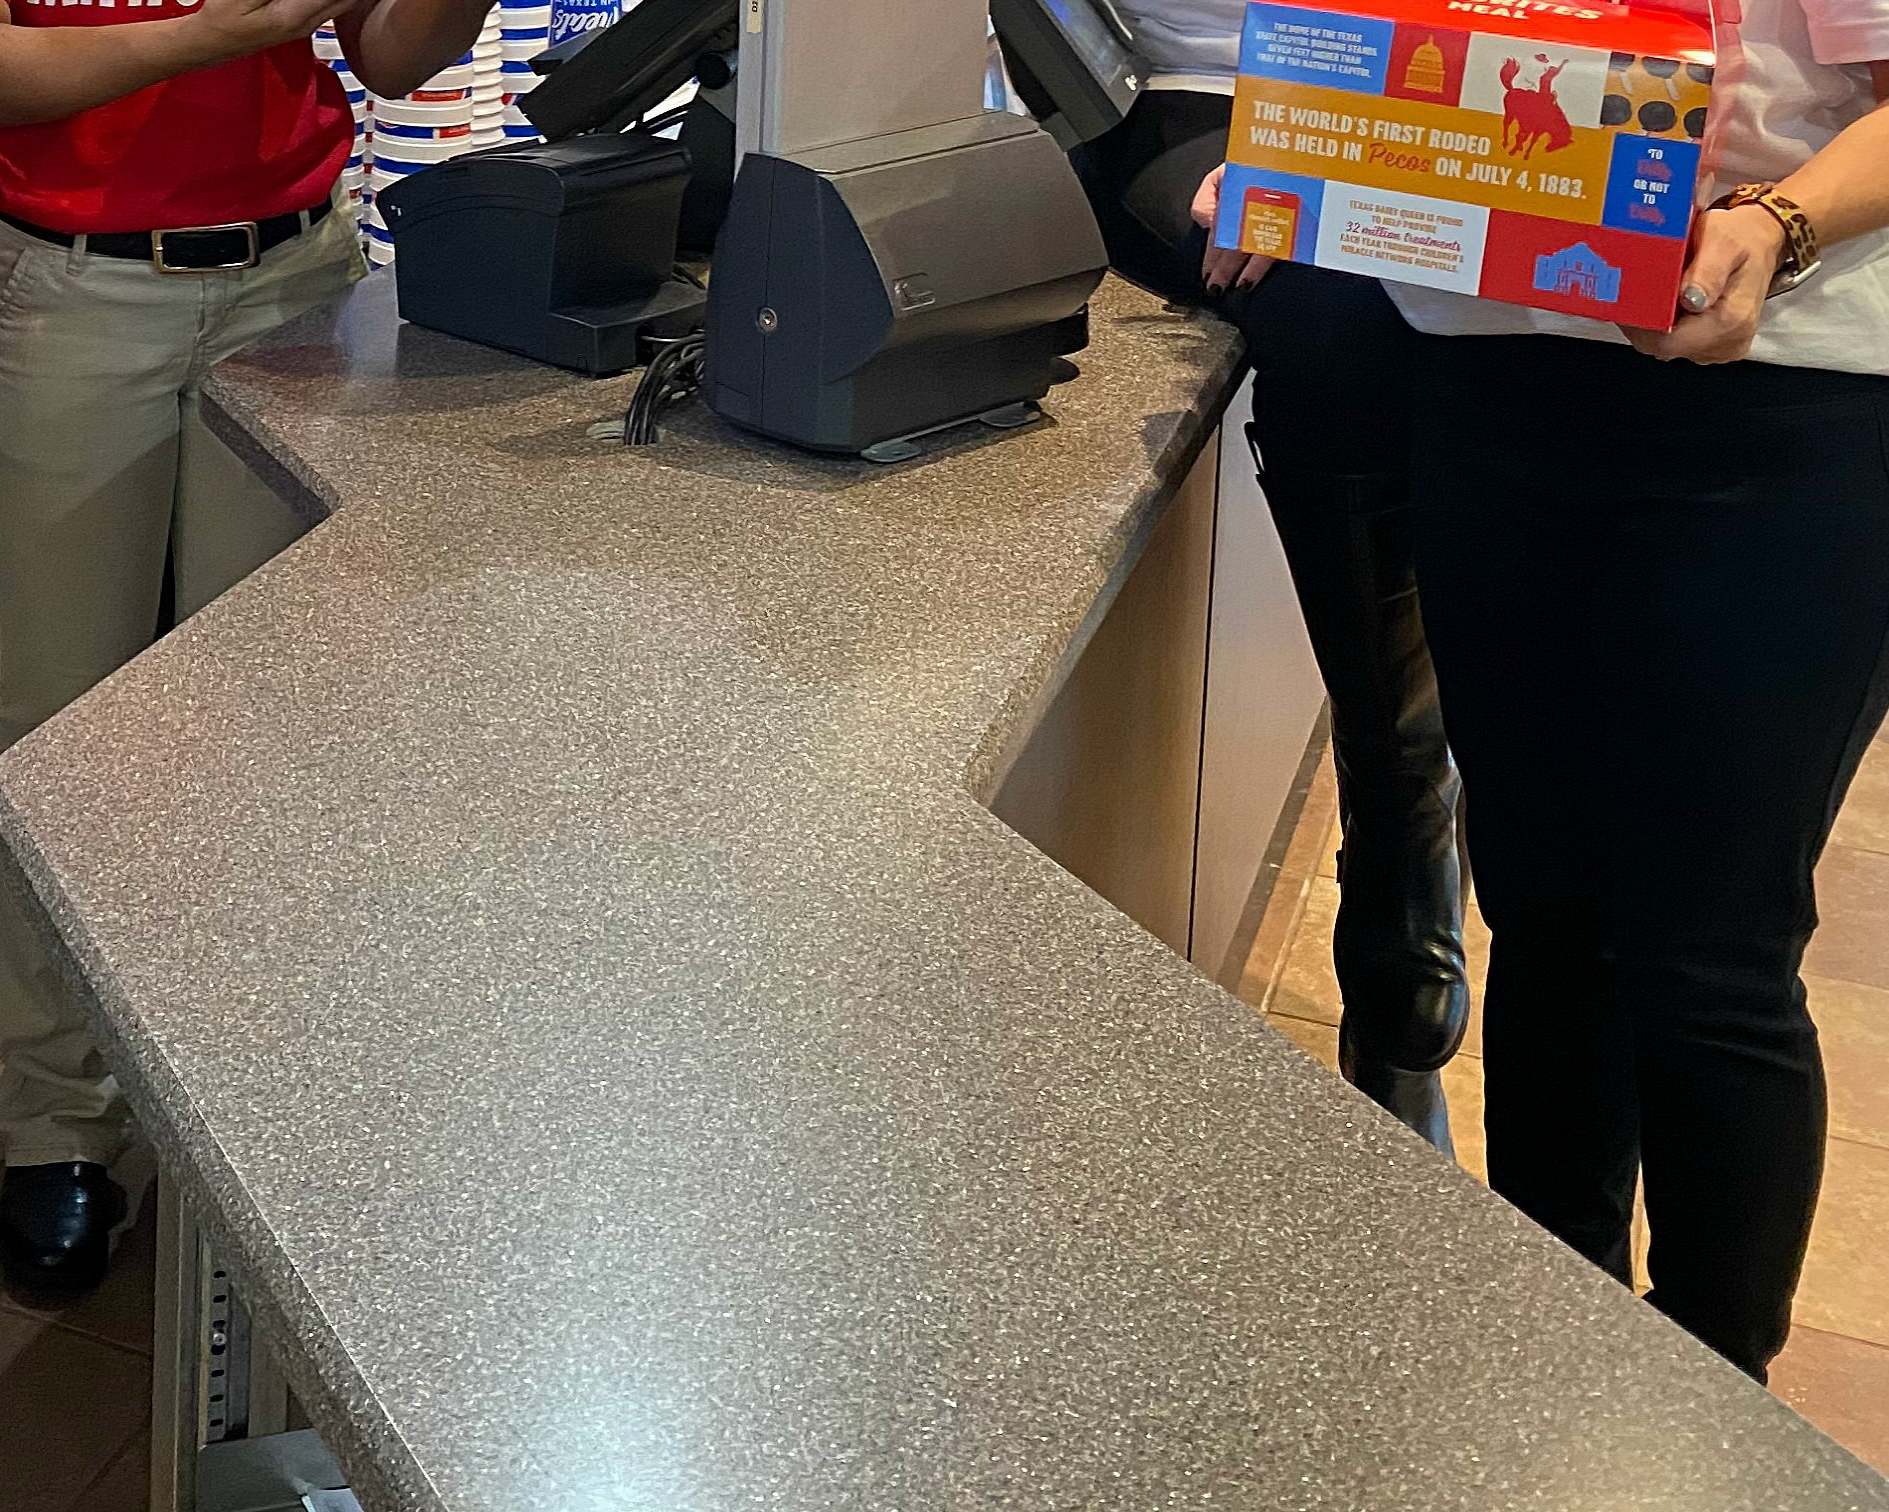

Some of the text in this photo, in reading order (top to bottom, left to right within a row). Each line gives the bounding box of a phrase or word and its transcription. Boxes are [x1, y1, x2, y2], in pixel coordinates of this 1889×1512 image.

[1447, 1, 1530, 20] MEAL
[1253, 100, 1492, 157] THE WORLD'S FIRST RODEO
[1647, 148, 1664, 160] TO
[1249, 126, 1588, 200] WAS HELD IN Pecos ON JULY 4, 1883.
[1649, 181, 1670, 194] NOT
[1643, 193, 1656, 205] TO
